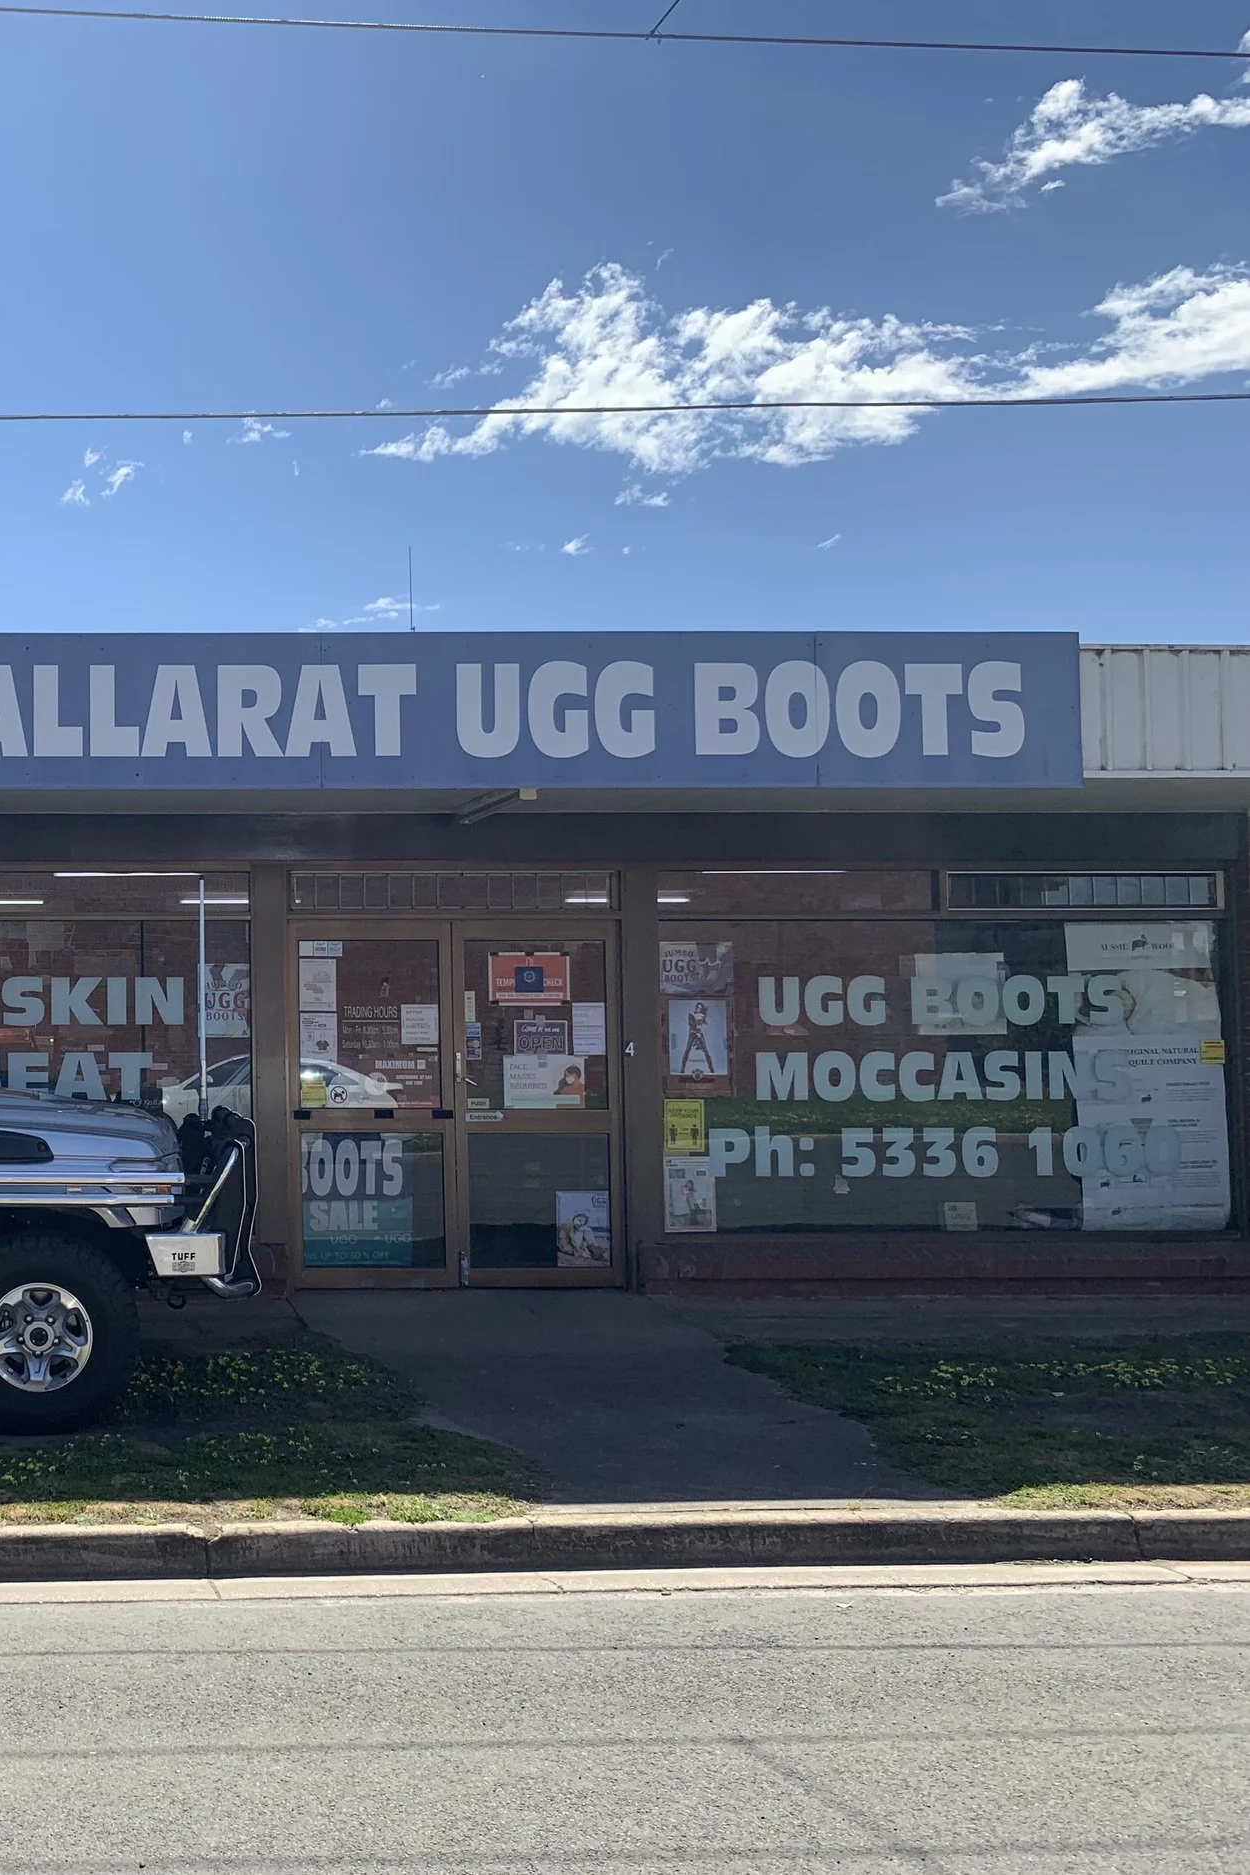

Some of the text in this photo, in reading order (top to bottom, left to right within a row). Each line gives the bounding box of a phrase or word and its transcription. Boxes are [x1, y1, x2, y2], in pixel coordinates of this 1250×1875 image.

[456, 660, 656, 758] UGG
[694, 660, 1026, 758] BOOTS
[662, 959, 696, 973] UGG
[664, 974, 696, 982] BOOTS
[204, 992, 246, 1009] UGG
[756, 974, 1125, 1027] UGG BOOTS
[343, 1005, 398, 1018] TRADING HOURS
[519, 1035, 564, 1051] OPEN
[625, 1041, 635, 1057] 4
[1161, 1047, 1198, 1055] NATURAL
[374, 1060, 415, 1070] MAXIMUM
[755, 1050, 1134, 1102] MOCCASINS
[510, 1082, 548, 1090] REQUIRED
[708, 1126, 816, 1178] Ph:
[840, 1126, 999, 1178] 5336
[1027, 1126, 1182, 1178] 1060
[310, 1199, 378, 1231] SALE
[171, 1252, 195, 1261] TUFF
[335, 1252, 348, 1260] TO
